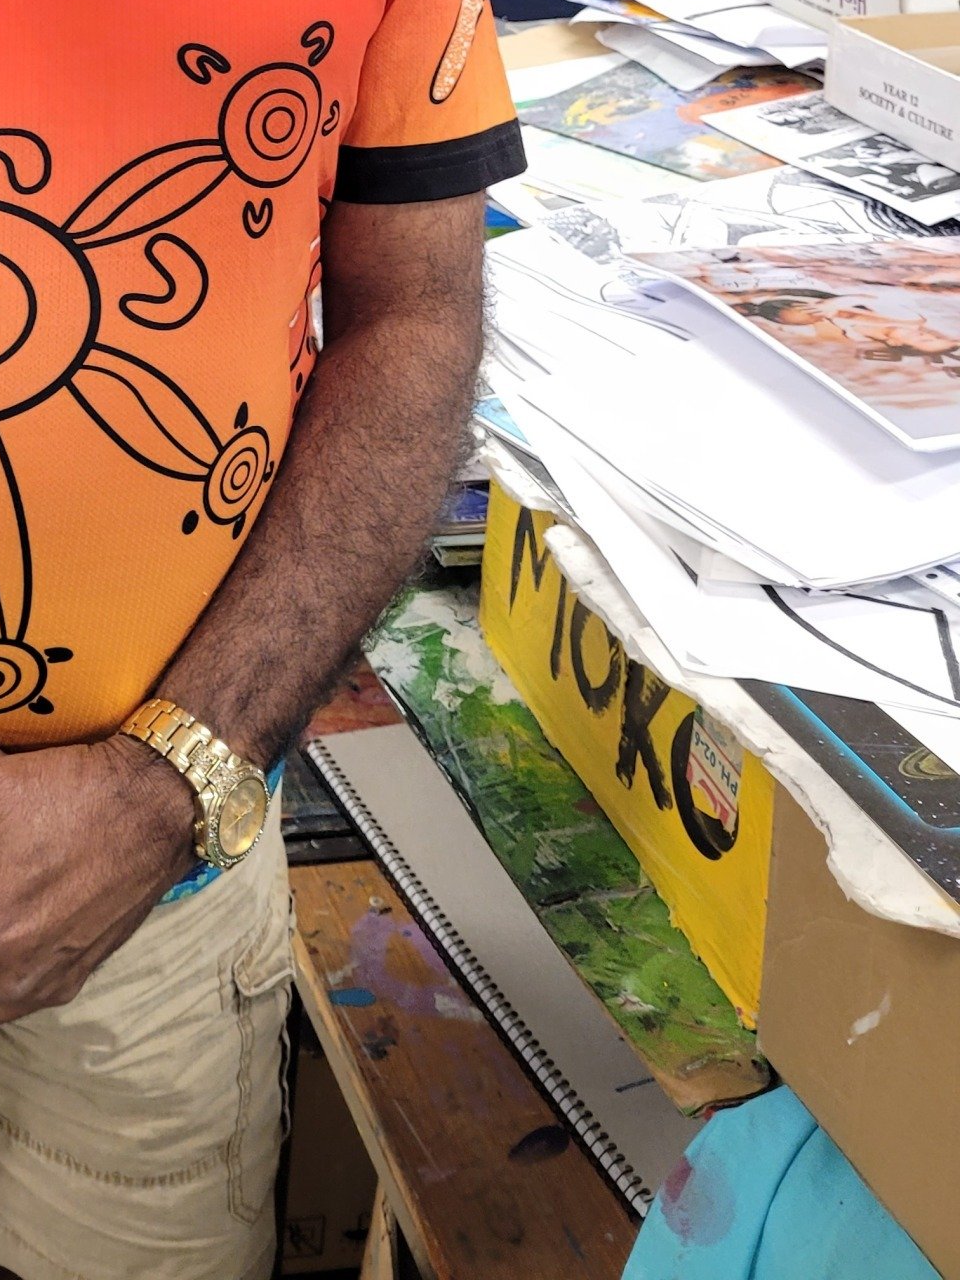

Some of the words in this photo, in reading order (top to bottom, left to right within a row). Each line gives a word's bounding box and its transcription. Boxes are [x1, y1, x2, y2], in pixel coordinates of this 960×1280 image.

[858, 86, 897, 114] SOCIETY
[898, 107, 906, 118] &
[907, 110, 954, 141] CULTURE
[883, 81, 908, 103] YEAR
[910, 94, 920, 108] 12
